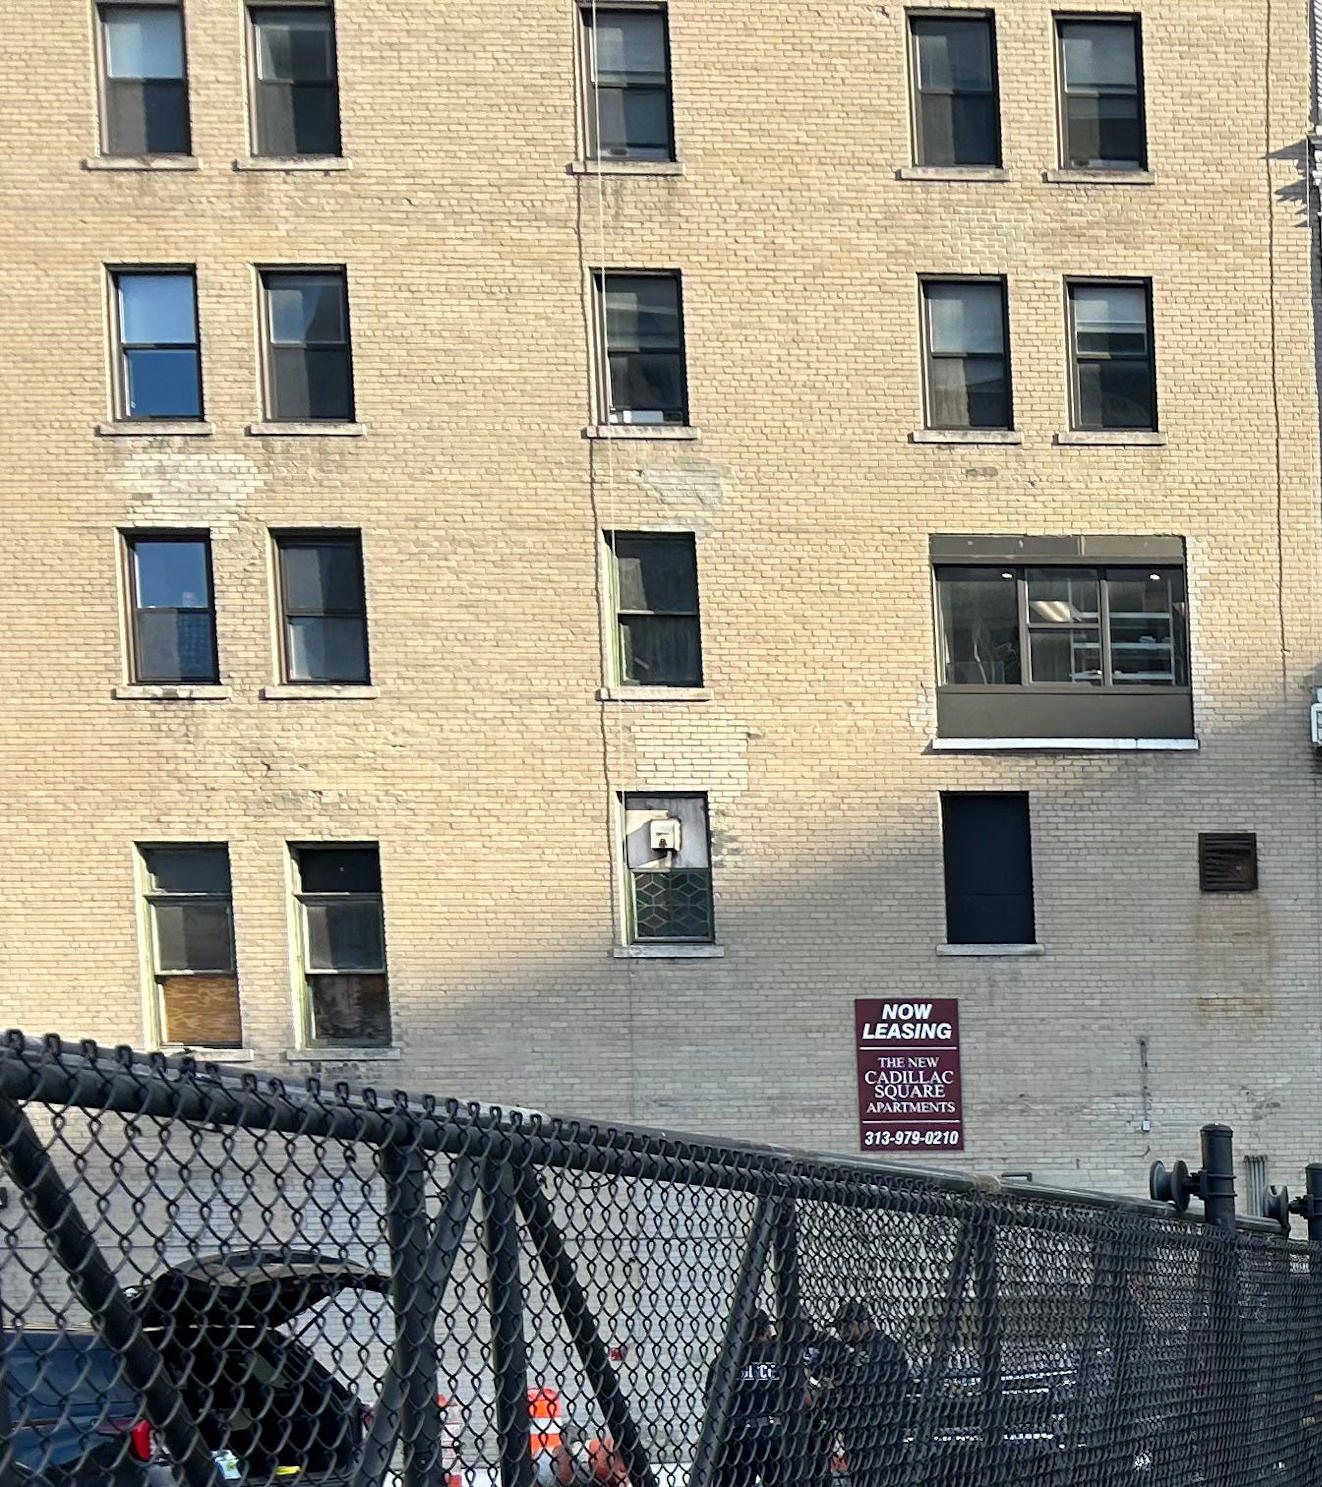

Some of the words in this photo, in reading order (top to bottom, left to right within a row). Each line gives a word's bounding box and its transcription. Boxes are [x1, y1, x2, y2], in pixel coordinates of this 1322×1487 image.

[881, 1003, 933, 1020] NOW
[862, 1022, 952, 1040] LEASING
[877, 1056, 906, 1068] THE
[908, 1056, 940, 1068] NEW
[864, 1070, 954, 1085] CADILLAC
[874, 1084, 946, 1101] SQUARE
[866, 1101, 956, 1114] APARTMENTS
[864, 1130, 959, 1146] 313-979-0210
